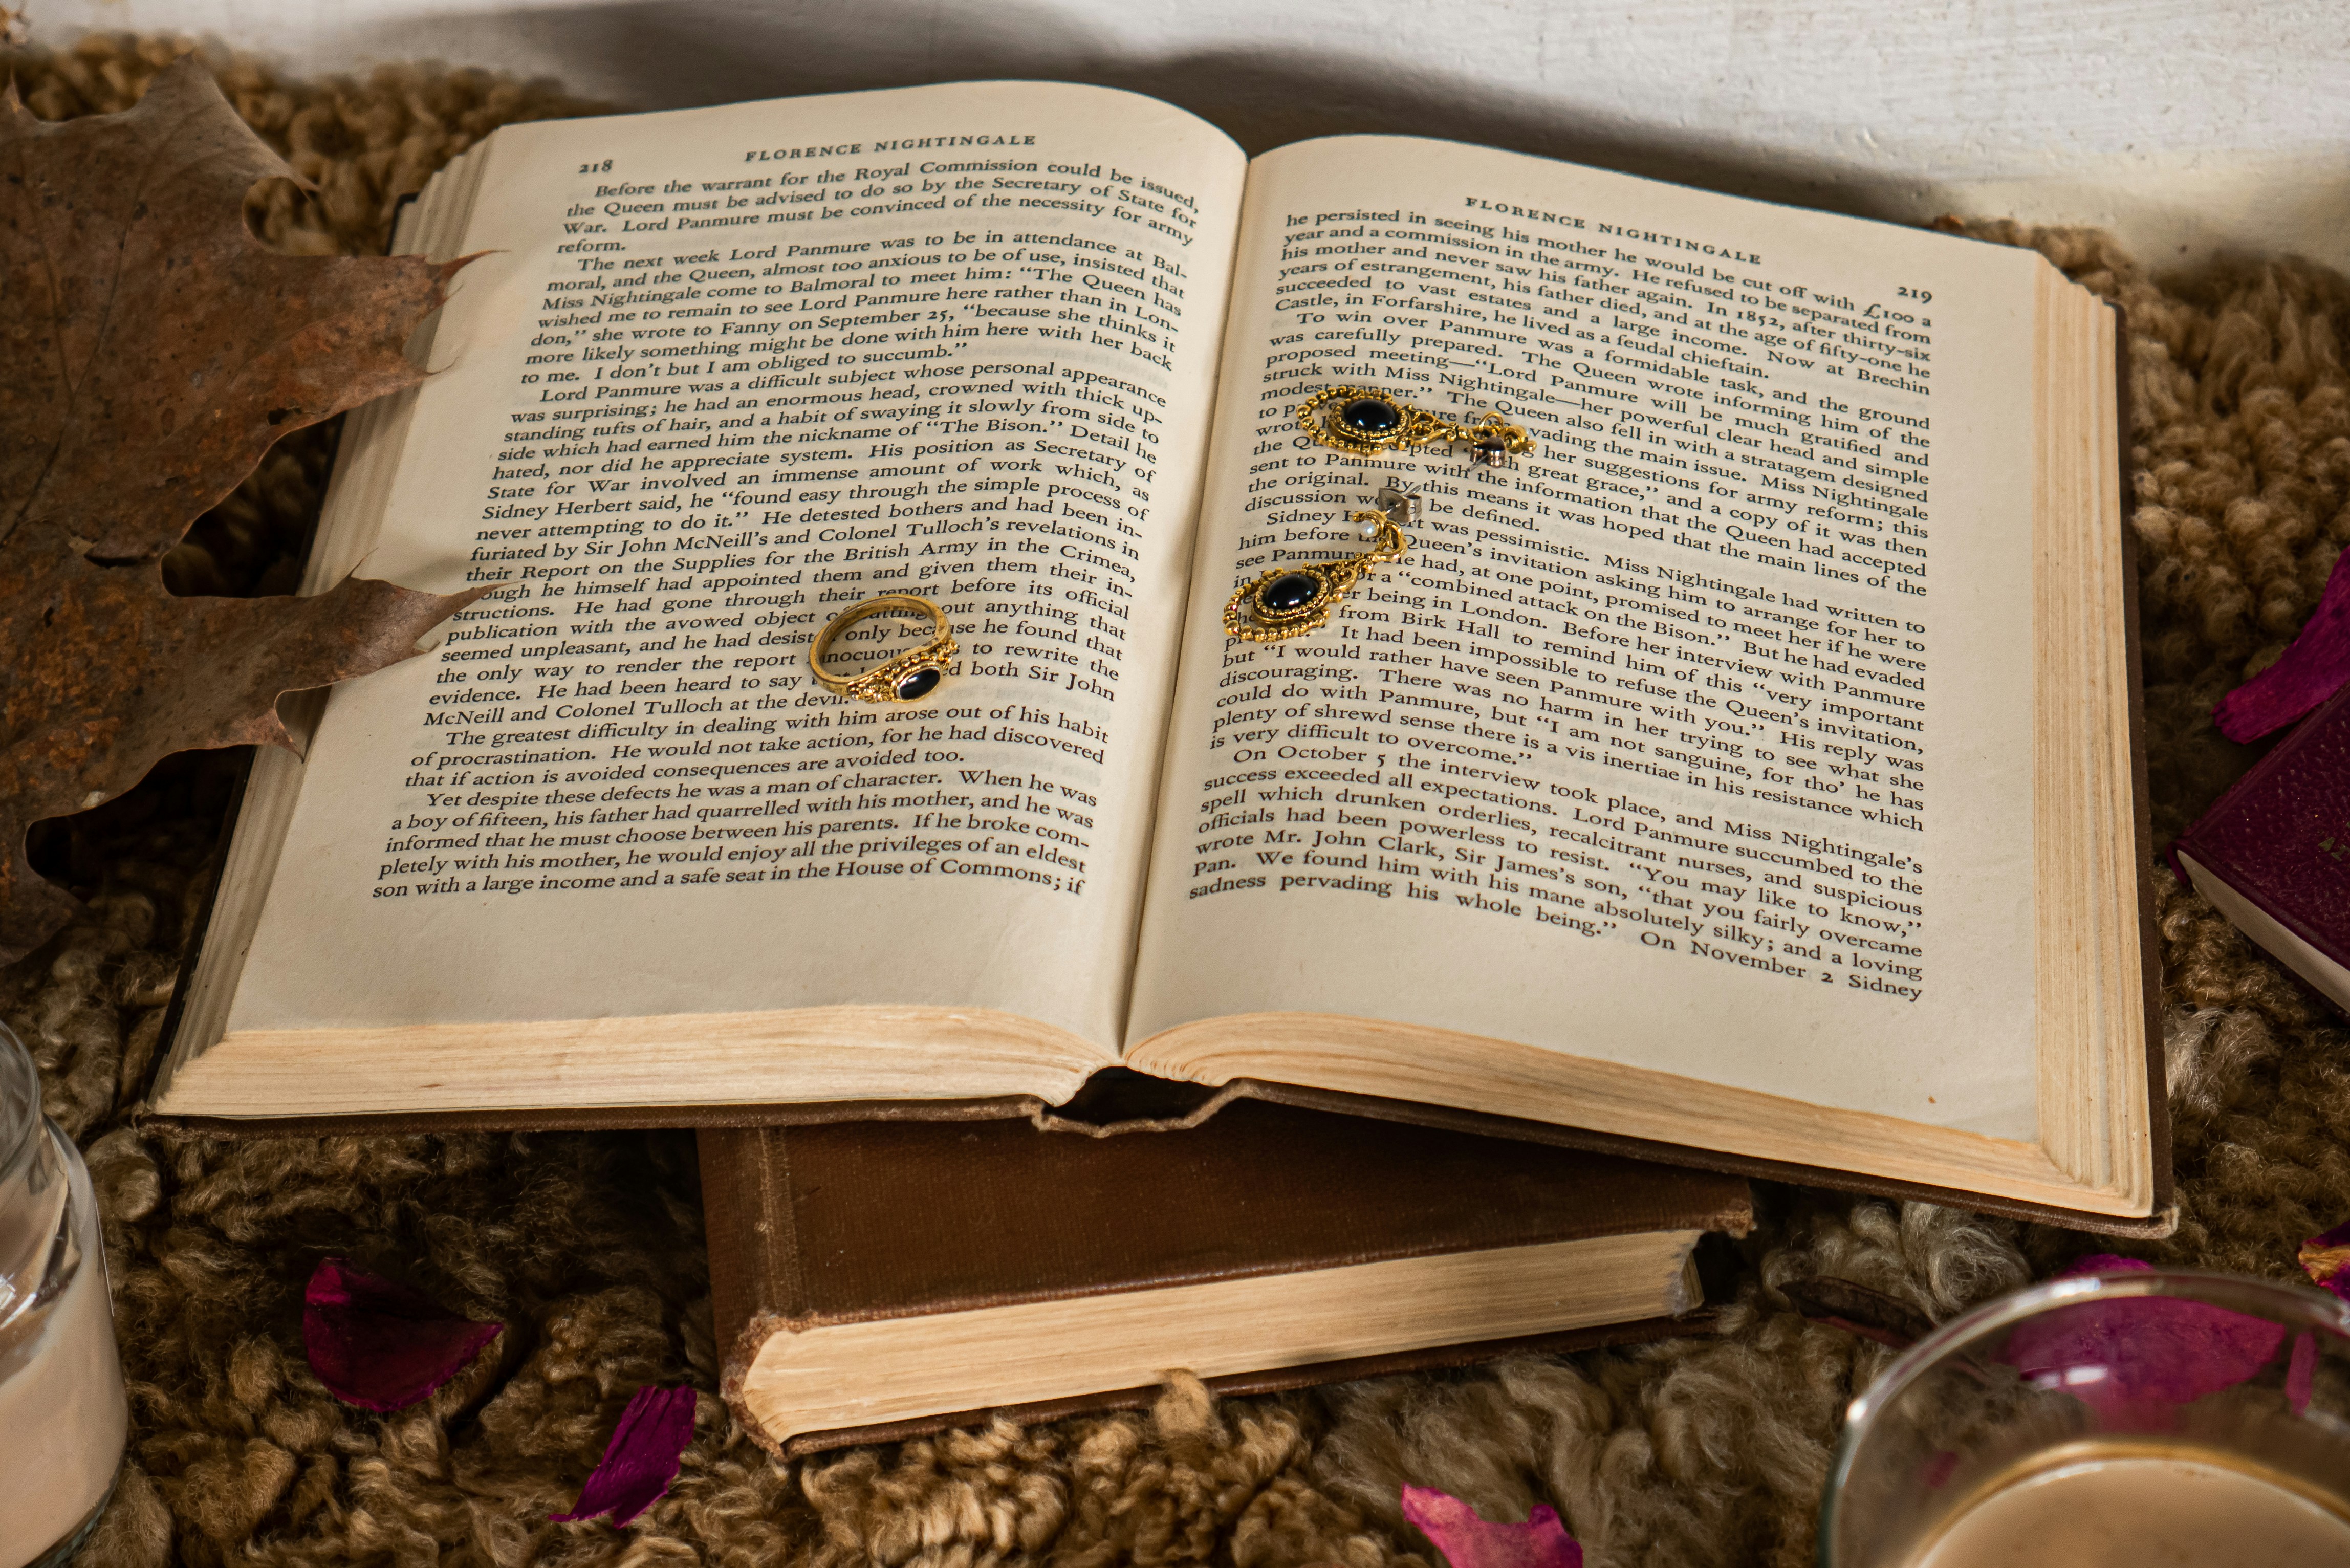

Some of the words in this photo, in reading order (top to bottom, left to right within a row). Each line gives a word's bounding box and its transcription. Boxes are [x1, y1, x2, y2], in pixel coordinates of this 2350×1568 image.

[578, 159, 613, 174] 218
[745, 143, 861, 162] FLORENCE
[874, 135, 1036, 153] NIGHTINGALE
[595, 184, 655, 198] Before
[663, 179, 692, 194] the
[701, 177, 772, 192] warrant
[780, 171, 809, 186] for
[816, 169, 846, 184] the
[854, 162, 910, 182] Royal
[919, 161, 1038, 175] Commission
[1047, 163, 1102, 178] could
[1109, 168, 1133, 185] be
[1140, 180, 1199, 214] issued,
[1465, 197, 1585, 229] FLORENCE
[1598, 223, 1761, 265] NIGHTINGALE
[541, 297, 584, 311] Miss
[590, 286, 702, 309] Nightingale
[706, 286, 758, 298] come
[764, 285, 783, 295] to
[789, 273, 876, 293] Balmoral
[881, 275, 901, 287] to
[910, 271, 957, 284] meet
[964, 266, 1011, 280] him:
[1082, 274, 1145, 301] Queen
[1153, 292, 1182, 317] has
[1286, 214, 1309, 227] he
[1315, 208, 1400, 226] persisted
[1408, 211, 1427, 225] in
[1434, 217, 1495, 239] seeing
[1502, 226, 1530, 244] his
[1537, 237, 1607, 258] mother
[1614, 247, 1637, 263] he
[1645, 257, 1704, 277] would
[1712, 268, 1735, 284] be
[1742, 278, 1772, 292] cut
[1779, 286, 1808, 299] off
[1813, 294, 1855, 311] with
[1921, 318, 1931, 328] a
[1897, 286, 1933, 304] 219
[520, 374, 540, 384] to
[547, 372, 580, 383] me.
[594, 366, 604, 380] I
[666, 362, 700, 376] but
[706, 361, 716, 374] I
[721, 362, 750, 373] am
[757, 352, 830, 372] obliged
[837, 355, 857, 365] to
[1296, 312, 1325, 325] To
[1335, 313, 1372, 323] win
[1383, 315, 1429, 328] over
[1439, 319, 1527, 345] Panmure
[1537, 339, 1574, 354] was
[1583, 349, 1594, 359] a
[1604, 349, 1710, 384] formidable
[1720, 378, 1765, 399] task,
[1772, 390, 1807, 405] and
[1818, 396, 1849, 413] the
[1858, 407, 1930, 430] ground
[472, 542, 548, 562] furiated
[552, 542, 579, 561] by
[583, 540, 614, 556] Sir
[616, 536, 667, 558] John
[773, 528, 811, 546] and
[818, 522, 897, 542] Colonel
[1005, 519, 1116, 550] revelations
[1121, 545, 1139, 561] in
[1266, 508, 1336, 526] Sidney
[1430, 521, 1469, 536] was
[1475, 529, 1590, 562] pessimistic.
[1603, 554, 1650, 575] Miss
[1657, 565, 1776, 603] Nightingale
[1782, 592, 1819, 613] had
[1825, 605, 1899, 629] written
[1905, 621, 1926, 634] to
[445, 730, 486, 746] The
[490, 728, 572, 749] greatest
[577, 720, 669, 741] difficulty
[674, 724, 695, 735] in
[702, 715, 778, 735] dealing
[785, 711, 830, 730] with
[837, 710, 877, 726] him
[884, 709, 939, 723] arose
[945, 707, 982, 719] out
[989, 704, 1017, 720] of
[1018, 705, 1050, 725] his
[1057, 712, 1108, 744] habit
[1215, 684, 1272, 708] could
[1281, 683, 1310, 698] do
[1319, 685, 1367, 701] with
[1378, 688, 1481, 720] Panmure,
[1491, 705, 1527, 727] but
[1569, 728, 1600, 743] am
[1609, 736, 1646, 753] not
[1654, 747, 1752, 781] sanguine,
[1762, 766, 1795, 786] for
[1855, 784, 1881, 802] he
[1890, 790, 1924, 811] has
[1233, 749, 1267, 764] On
[1277, 745, 1368, 763] October
[1398, 752, 1431, 771] the
[1440, 762, 1541, 791] interview
[1550, 783, 1598, 804] took
[1606, 795, 1666, 823] place,
[1675, 814, 1713, 831] and
[1724, 820, 1772, 841] Miss
[372, 885, 408, 899] son
[415, 876, 460, 896] with
[465, 881, 477, 892] a
[481, 874, 535, 895] large
[538, 877, 616, 890] income
[619, 869, 659, 888] and
[663, 874, 675, 885] a
[680, 866, 721, 885] safe
[725, 869, 767, 883] seat
[770, 869, 791, 881] in
[797, 861, 831, 879] the
[835, 861, 905, 877] House
[909, 857, 937, 875] of
[940, 859, 1061, 891] Commons;
[1066, 879, 1086, 896] if
[1195, 834, 1254, 855] wrote
[1264, 829, 1302, 844] Mr.
[1311, 830, 1366, 848] John
[1377, 836, 1445, 862] Clark,
[1454, 847, 1486, 865] Sir
[1584, 878, 1628, 901] son,
[1702, 903, 1744, 921] you
[1753, 908, 1810, 939] fairly
[1819, 929, 1923, 958] overcame
[1189, 876, 1267, 900] sadness
[1279, 874, 1393, 899] pervading
[1407, 881, 1439, 902] his
[1455, 892, 1522, 917] whole
[1640, 931, 1676, 951] On
[1690, 940, 1807, 978] November
[1821, 972, 1834, 984] 2
[1848, 974, 1923, 1003] Sidney
